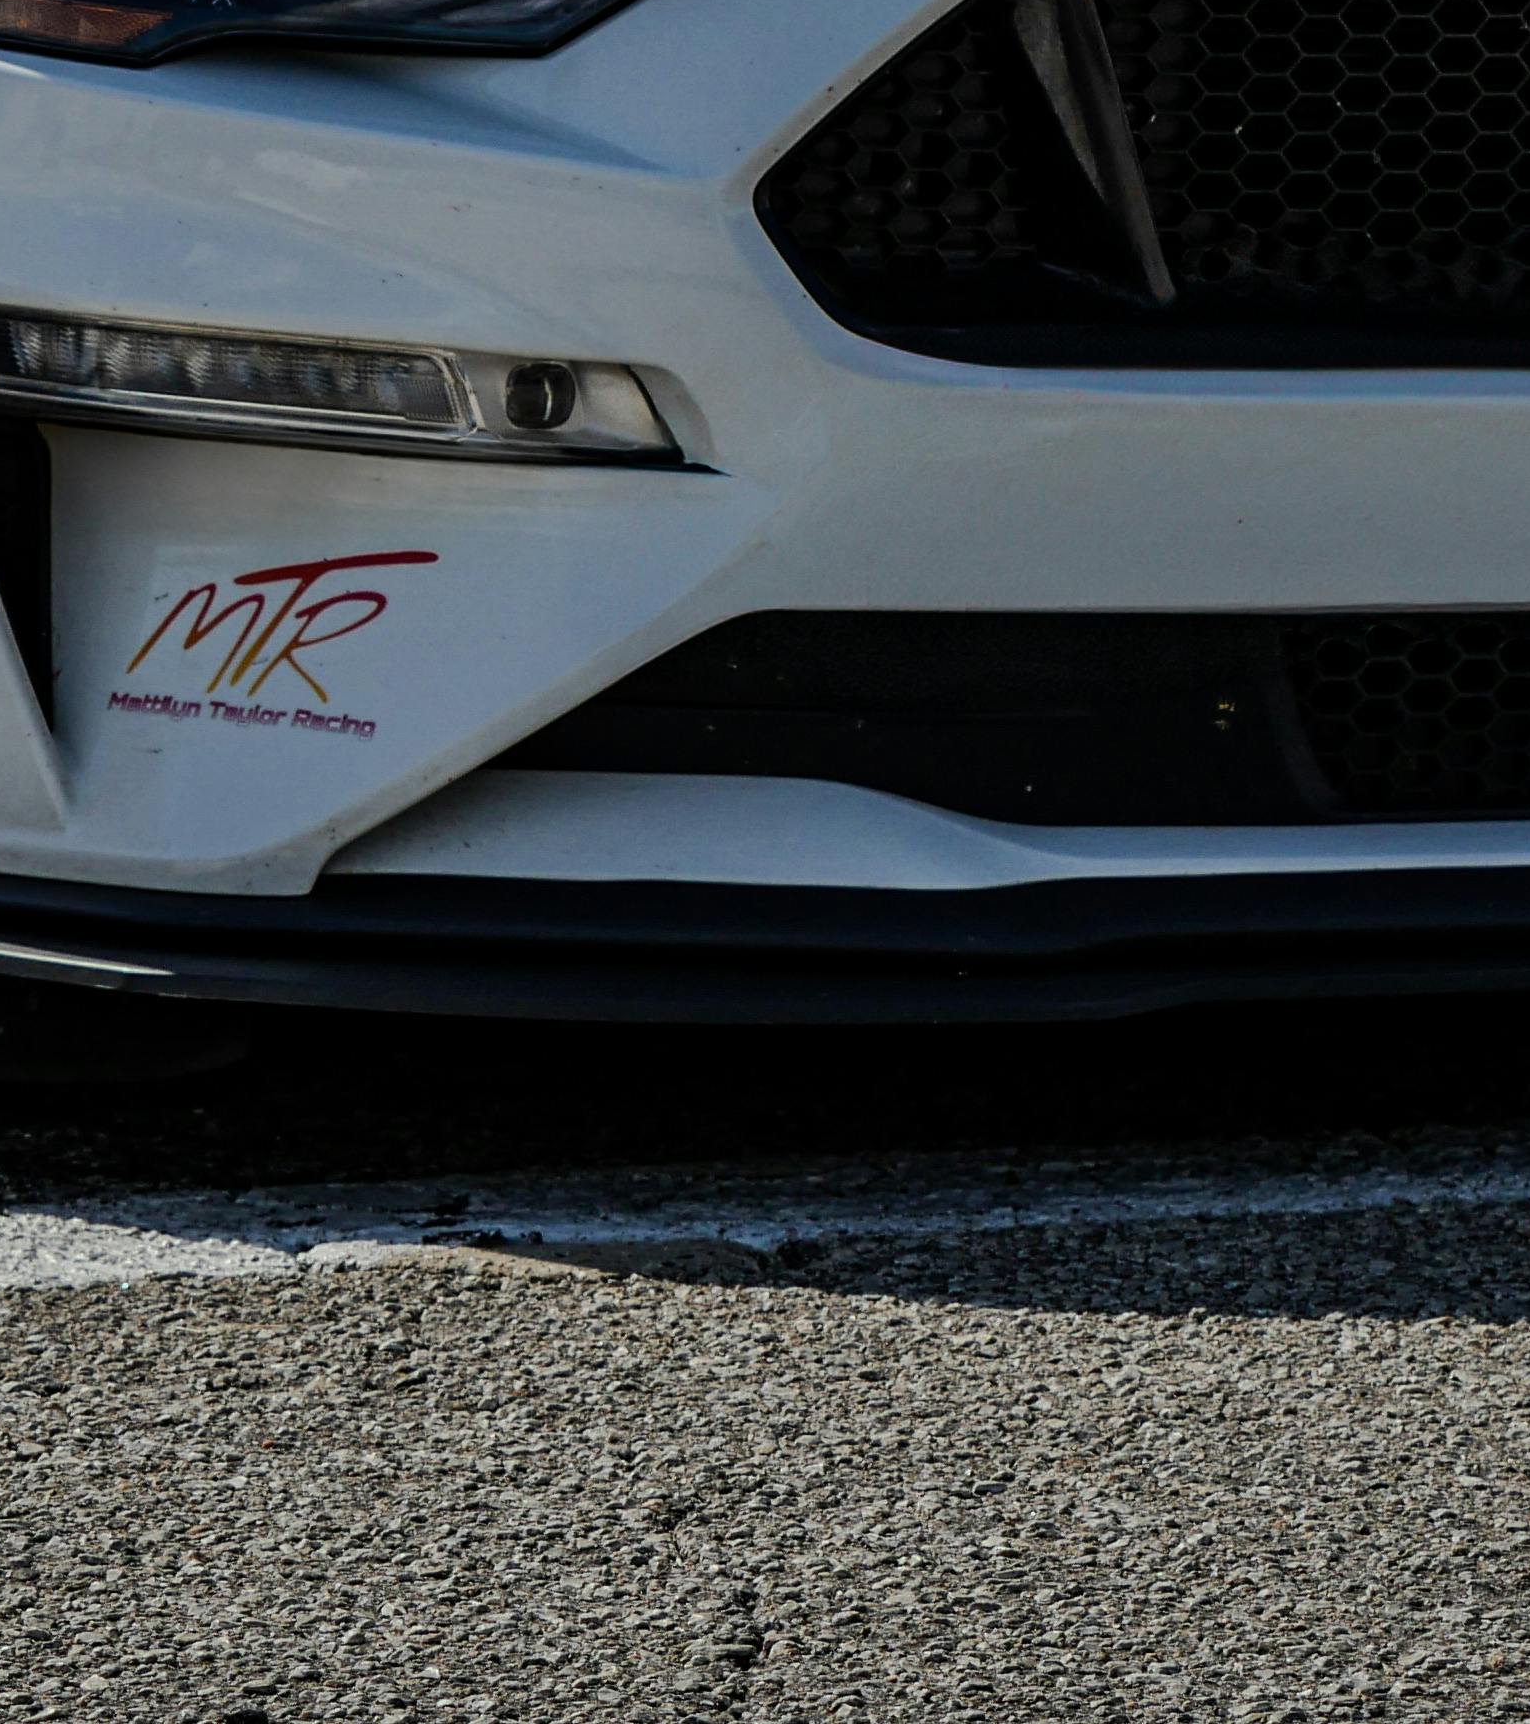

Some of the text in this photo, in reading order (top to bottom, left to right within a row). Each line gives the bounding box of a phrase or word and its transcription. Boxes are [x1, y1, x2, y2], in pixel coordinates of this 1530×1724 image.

[125, 550, 439, 704] MTR
[209, 700, 287, 727] Taylor
[291, 707, 377, 740] Racing
